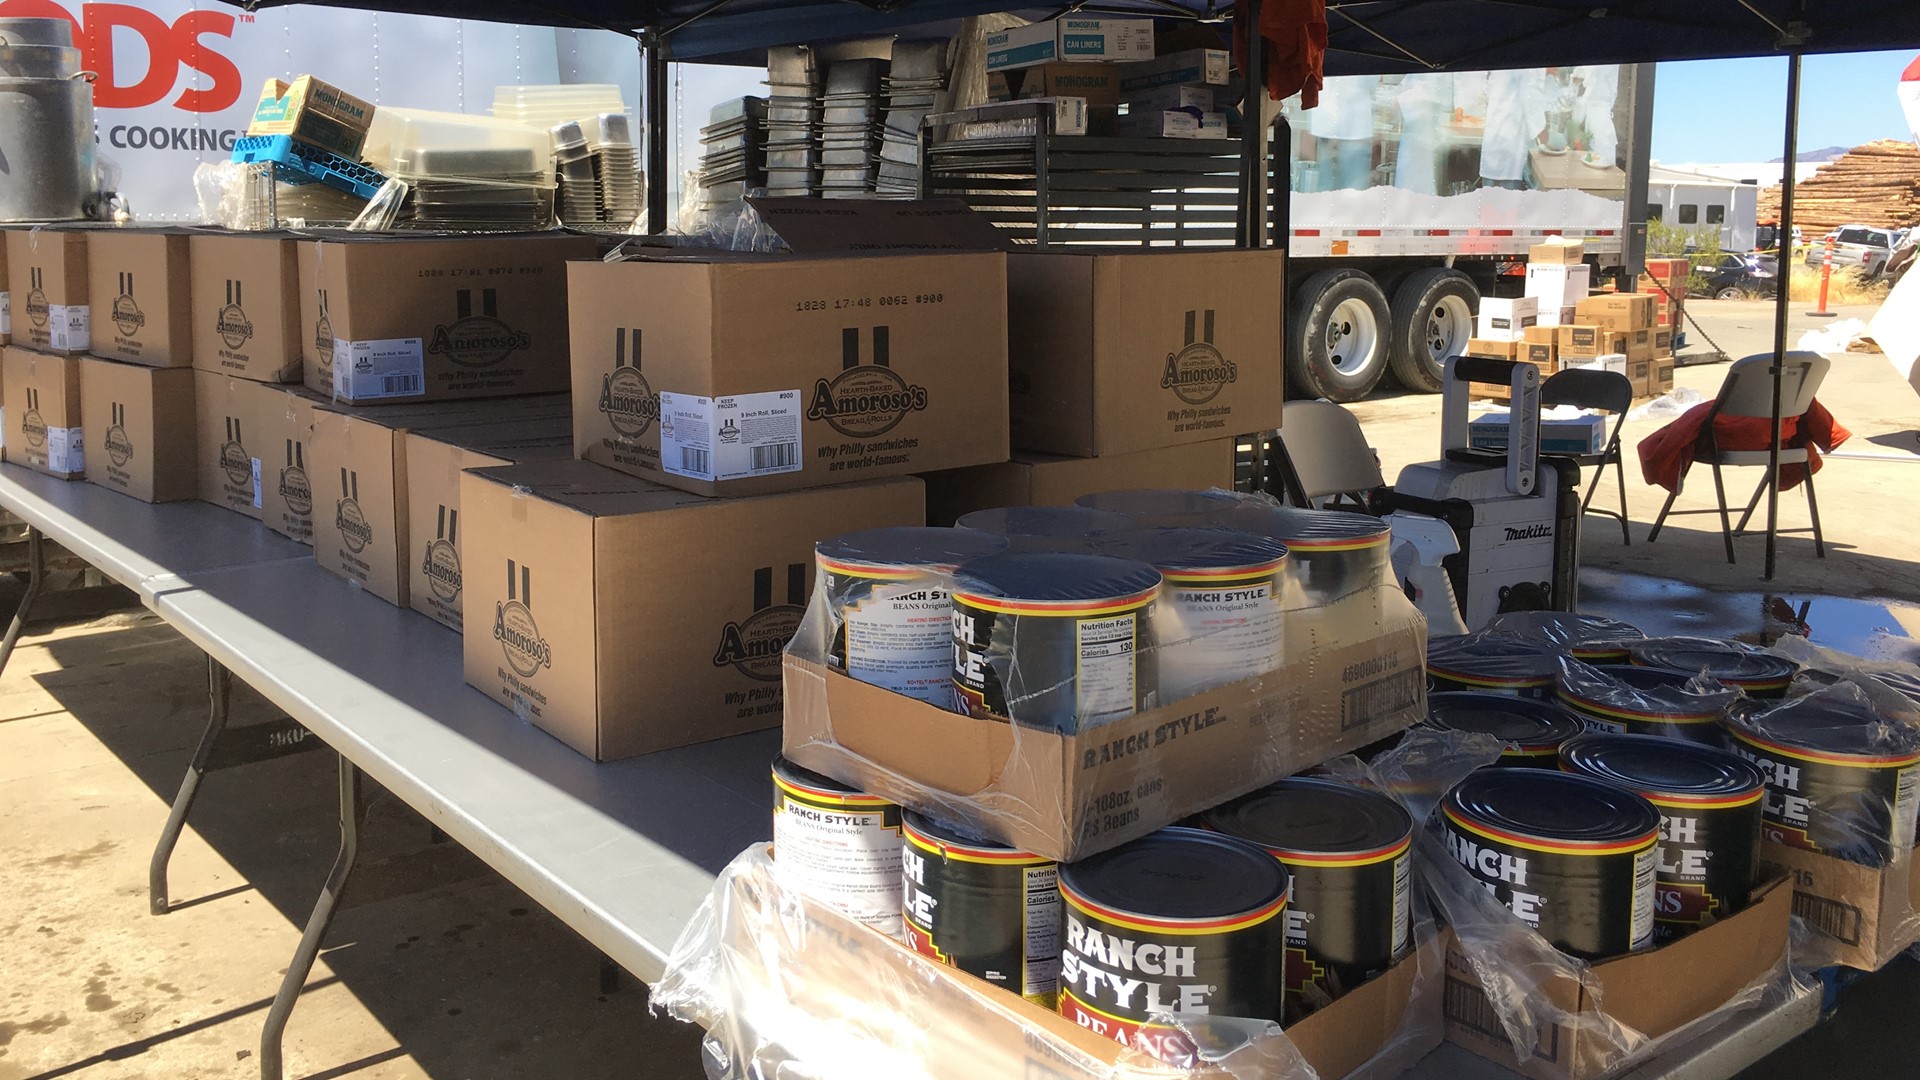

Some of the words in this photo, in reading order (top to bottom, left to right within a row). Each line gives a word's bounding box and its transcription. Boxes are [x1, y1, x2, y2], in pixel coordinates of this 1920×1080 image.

[1067, 21, 1100, 29] MONOGRAM
[1066, 41, 1079, 49] CAN
[1080, 40, 1102, 49] LINERS
[1055, 75, 1109, 88] MONOGRAM
[109, 125, 236, 152] COOKING
[834, 297, 872, 309] 17:48
[216, 307, 254, 339] Amoroso's
[428, 324, 531, 355] Amoroso's
[1160, 352, 1237, 389] Amoroso's
[779, 392, 794, 400] #900
[839, 384, 893, 394] HEARTH-BAKED
[717, 402, 738, 410] FROZEN
[807, 377, 927, 421] Amoroso's
[770, 408, 787, 416] Sliced
[1167, 410, 1180, 421] Why
[1180, 408, 1197, 420] Philly
[1197, 405, 1232, 417] sandwiches
[1174, 424, 1184, 432] are
[817, 445, 838, 459] Why
[839, 441, 866, 456] Philly
[866, 437, 919, 453] sandwiches
[829, 461, 845, 472] are
[336, 498, 372, 545] Amoroso's
[422, 540, 462, 591] Amoroso
[1176, 592, 1221, 603] RANCH
[1223, 588, 1264, 603] STYLE
[921, 601, 952, 611] Original
[1215, 603, 1244, 613] Original
[1244, 601, 1260, 611] Style
[1080, 621, 1115, 631] Nutrition
[1115, 617, 1133, 628] Facts
[493, 600, 552, 669] Amoroso's
[1080, 649, 1109, 657] Calories
[1119, 641, 1133, 652] 130
[750, 660, 776, 670] BREAD
[497, 667, 507, 682] Why
[507, 673, 520, 691] Philly
[519, 682, 547, 706] sandwiches
[966, 678, 985, 689] BRAND
[502, 686, 510, 698] are
[724, 691, 746, 705] Why
[748, 687, 777, 701] Philly
[737, 707, 754, 718] are
[1586, 719, 1616, 734] TYLE
[1083, 730, 1149, 770] RANCH
[1153, 708, 1217, 748] STYLE
[1137, 778, 1163, 799] cans
[788, 803, 821, 822] RANCH
[824, 814, 872, 826] STYLE
[1103, 807, 1140, 833] Beans
[795, 818, 816, 829] BEANS
[816, 824, 844, 835] Original
[845, 827, 864, 837] Style
[1783, 817, 1808, 828] BRAND
[1027, 870, 1057, 879] Nutritio
[1027, 895, 1055, 904] Calories
[914, 917, 933, 929] BRAND
[1067, 913, 1197, 978] RANCH
